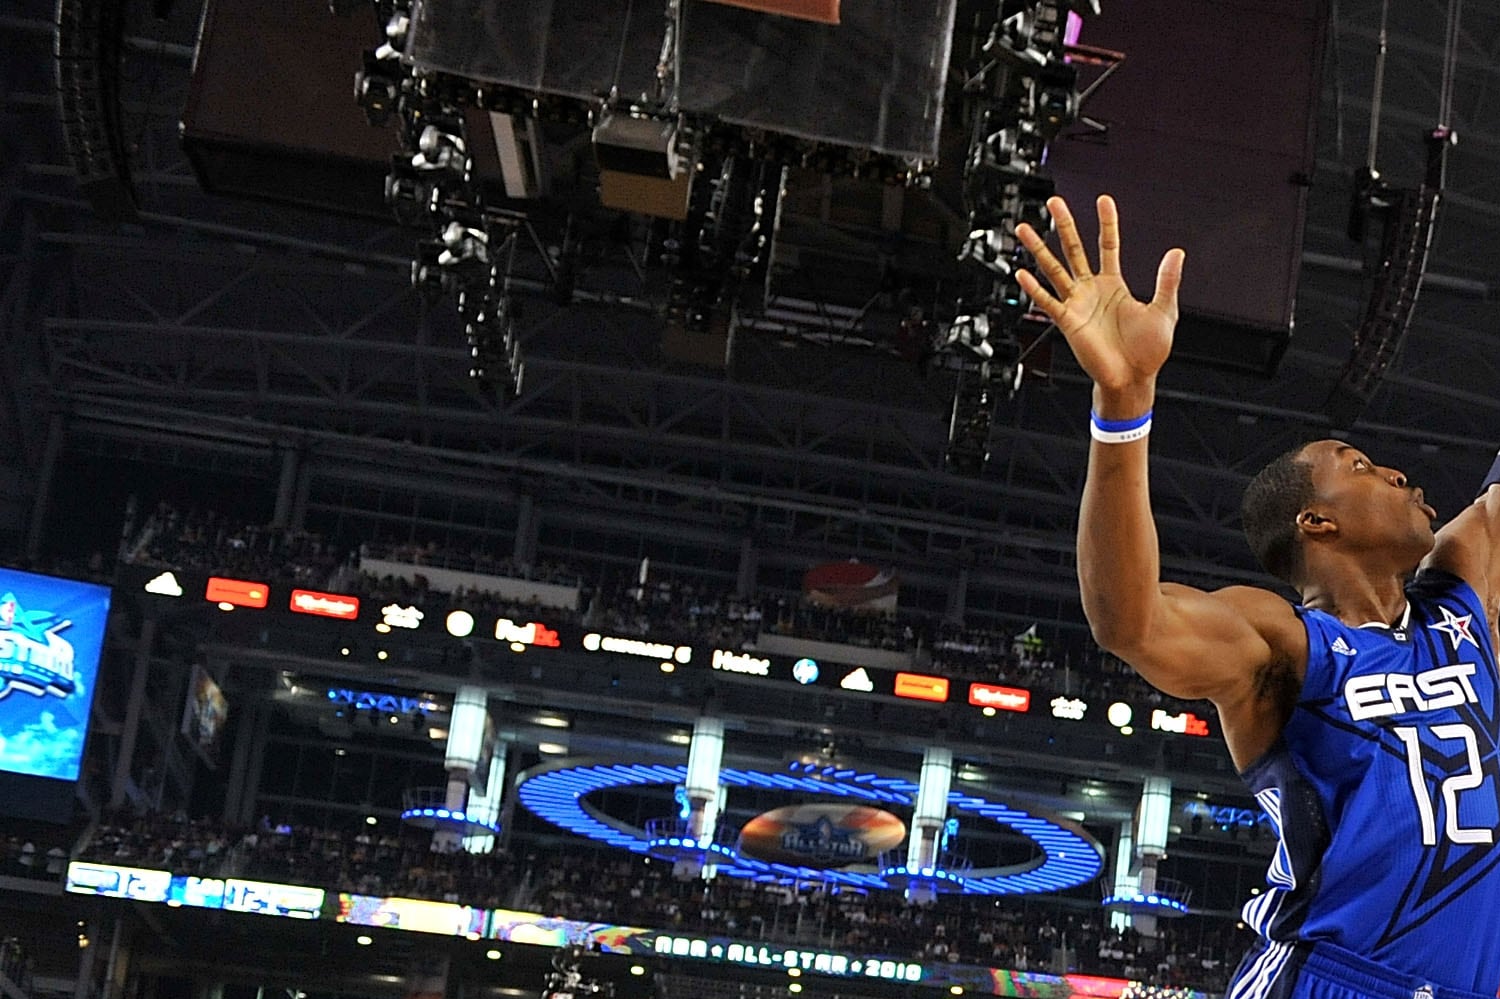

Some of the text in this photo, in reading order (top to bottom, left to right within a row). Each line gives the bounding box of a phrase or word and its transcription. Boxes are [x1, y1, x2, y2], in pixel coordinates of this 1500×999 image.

[1344, 663, 1478, 722] EAST
[1393, 723, 1493, 846] 12
[727, 943, 848, 975] ALL-STAR
[865, 959, 921, 982] 2010
